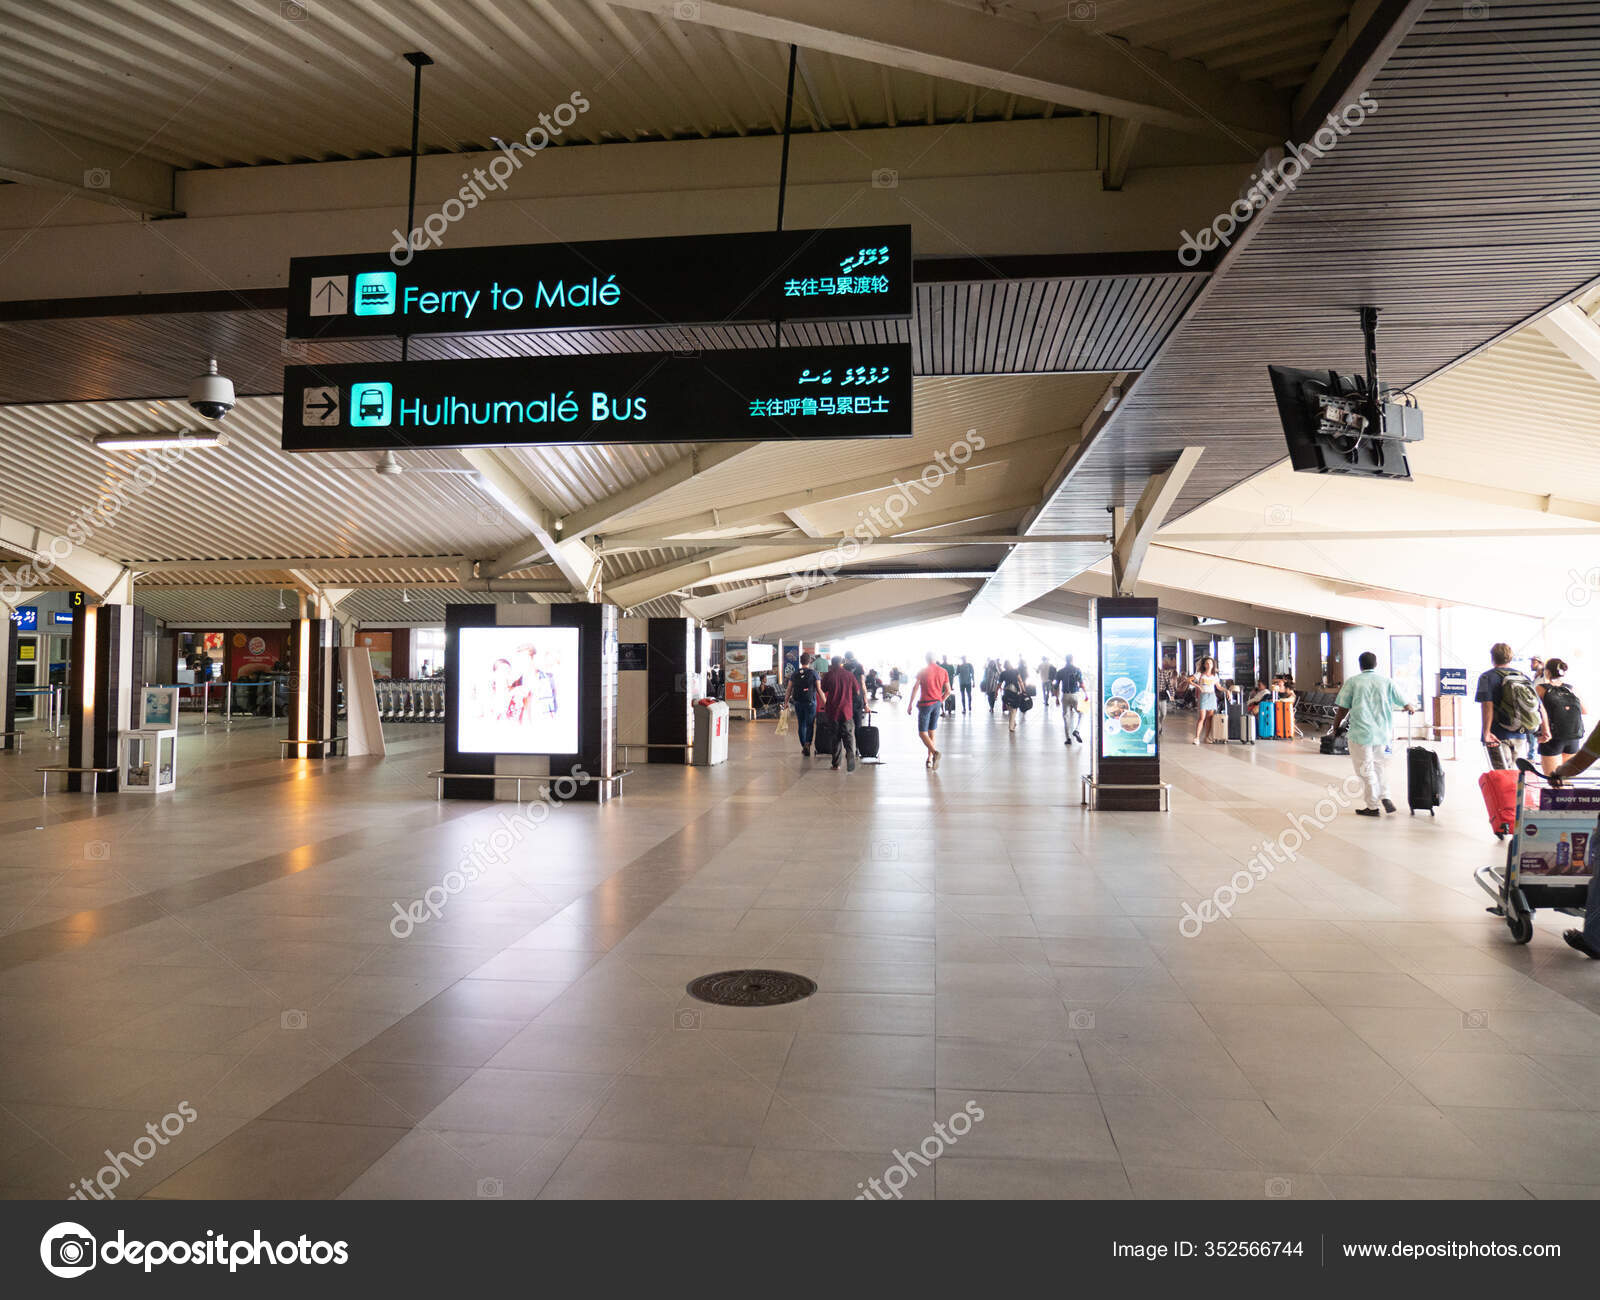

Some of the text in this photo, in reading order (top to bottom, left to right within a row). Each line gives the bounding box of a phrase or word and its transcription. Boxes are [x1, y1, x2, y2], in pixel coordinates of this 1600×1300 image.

[403, 274, 621, 319] Ferry to Malé
[784, 275, 889, 296] 去往马累渡轮
[400, 390, 647, 426] Hulhumalé Bus
[748, 395, 890, 417] 去往呼鲁马累巴士
[74, 592, 82, 606] 5
